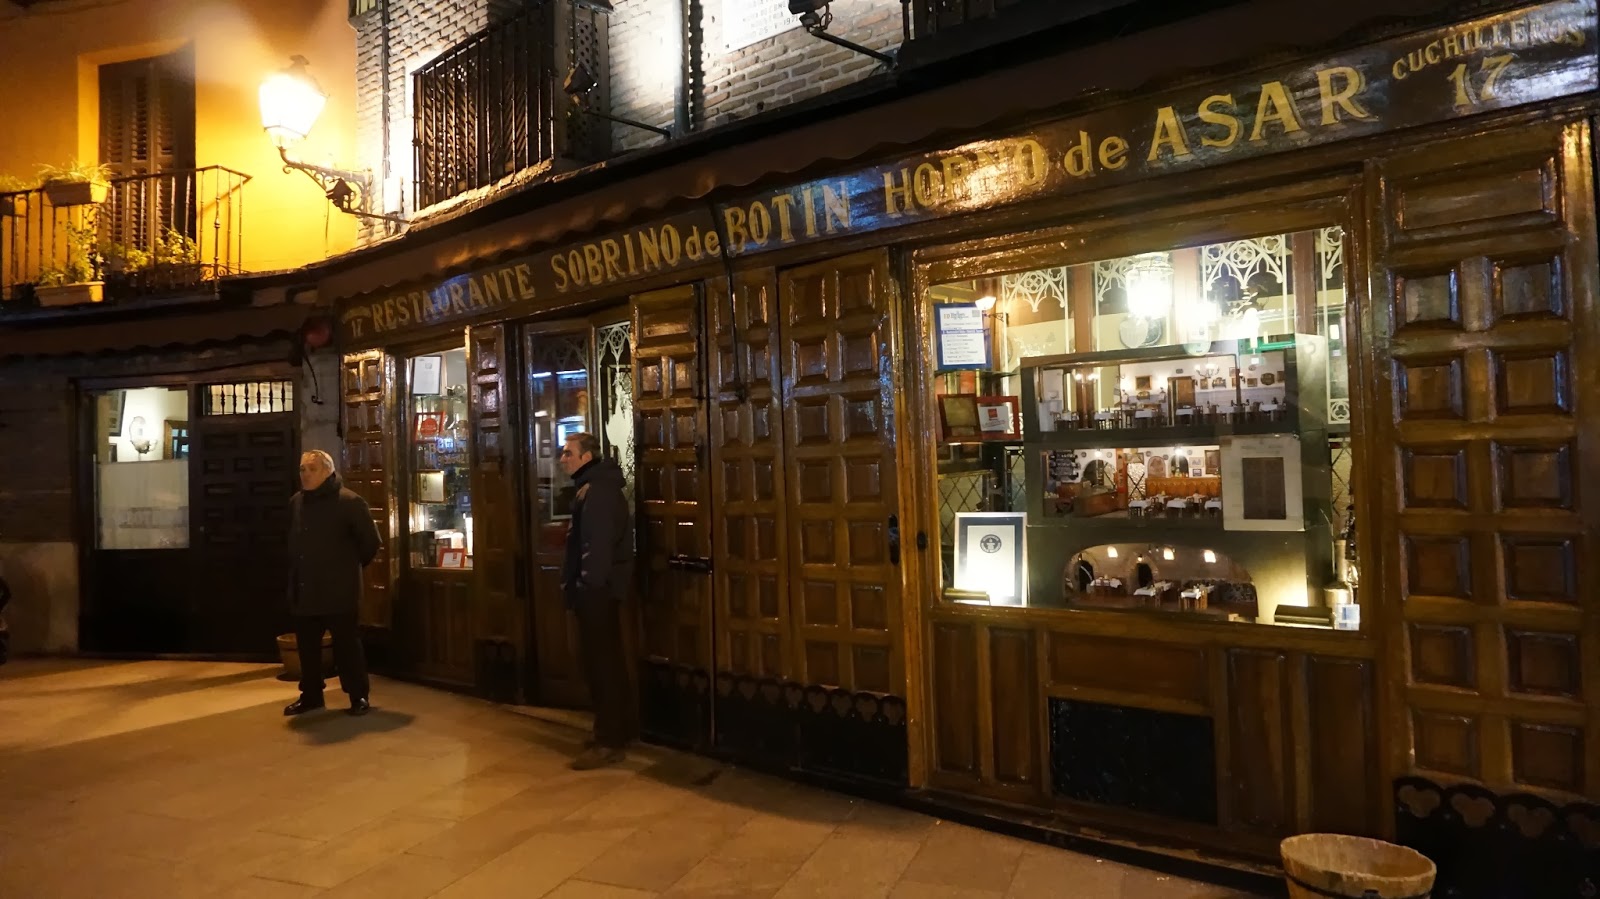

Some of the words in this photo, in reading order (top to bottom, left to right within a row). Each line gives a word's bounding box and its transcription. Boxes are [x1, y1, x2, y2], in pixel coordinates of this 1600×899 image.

[1392, 18, 1586, 80] CUCHILLEROS
[1447, 52, 1519, 107] 17
[371, 263, 536, 333] RESTAURANTE
[551, 223, 681, 293] SOBRINO
[685, 225, 722, 262] de
[724, 180, 850, 255] BOTIN
[1064, 130, 1129, 178] de
[1147, 66, 1380, 163] ASAR
